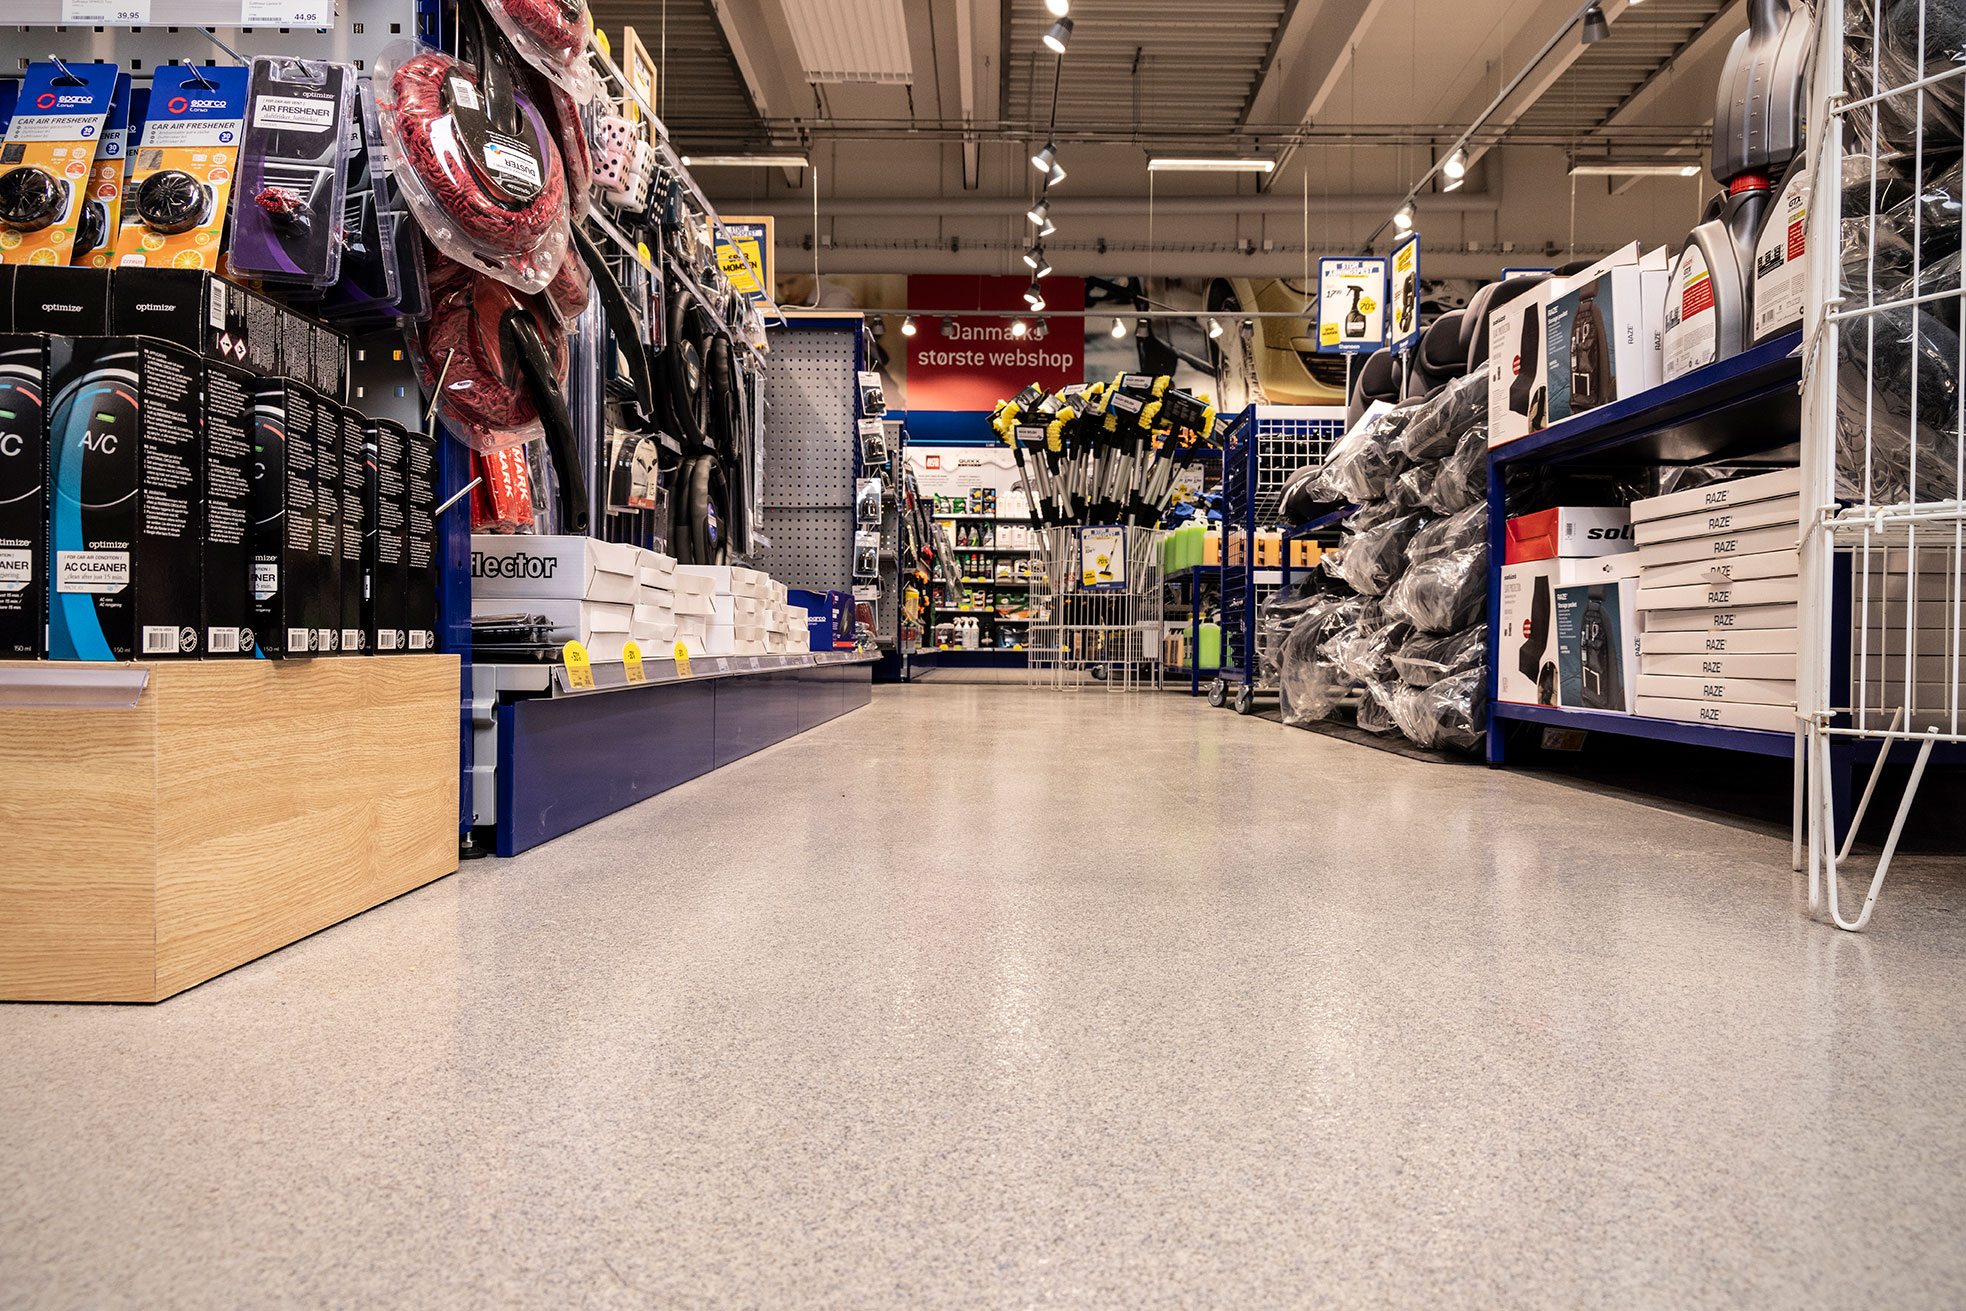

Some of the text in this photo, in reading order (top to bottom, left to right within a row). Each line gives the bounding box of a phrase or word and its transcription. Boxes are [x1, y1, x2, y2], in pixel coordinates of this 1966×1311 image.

[294, 13, 316, 21] 44,95
[58, 95, 93, 104] sparco
[190, 100, 227, 108] sparco
[261, 104, 330, 116] AIR FRESHENER
[84, 126, 93, 134] 30
[504, 158, 536, 176] DUSTER
[728, 252, 750, 262] SPR
[723, 261, 758, 272] MOMSN
[42, 304, 83, 312] optimize
[136, 304, 176, 312] optimize
[948, 322, 1044, 341] Danmaks
[1654, 330, 1662, 350] RAZE
[918, 349, 1073, 372] største webshop
[78, 430, 118, 454] A/C
[1705, 490, 1727, 504] RAZE
[1709, 516, 1730, 530] RAZE
[1588, 525, 1634, 540] sol
[89, 541, 129, 550] optimize
[1714, 541, 1736, 554] RAZE
[64, 562, 127, 572] AC CLEANER
[1708, 592, 1729, 602] RAZE
[1714, 614, 1734, 626] RAZE
[1706, 640, 1725, 650] RAZE
[1703, 662, 1721, 673] RAZE
[1704, 685, 1723, 697] RAZE
[1700, 708, 1719, 720] RAZE
